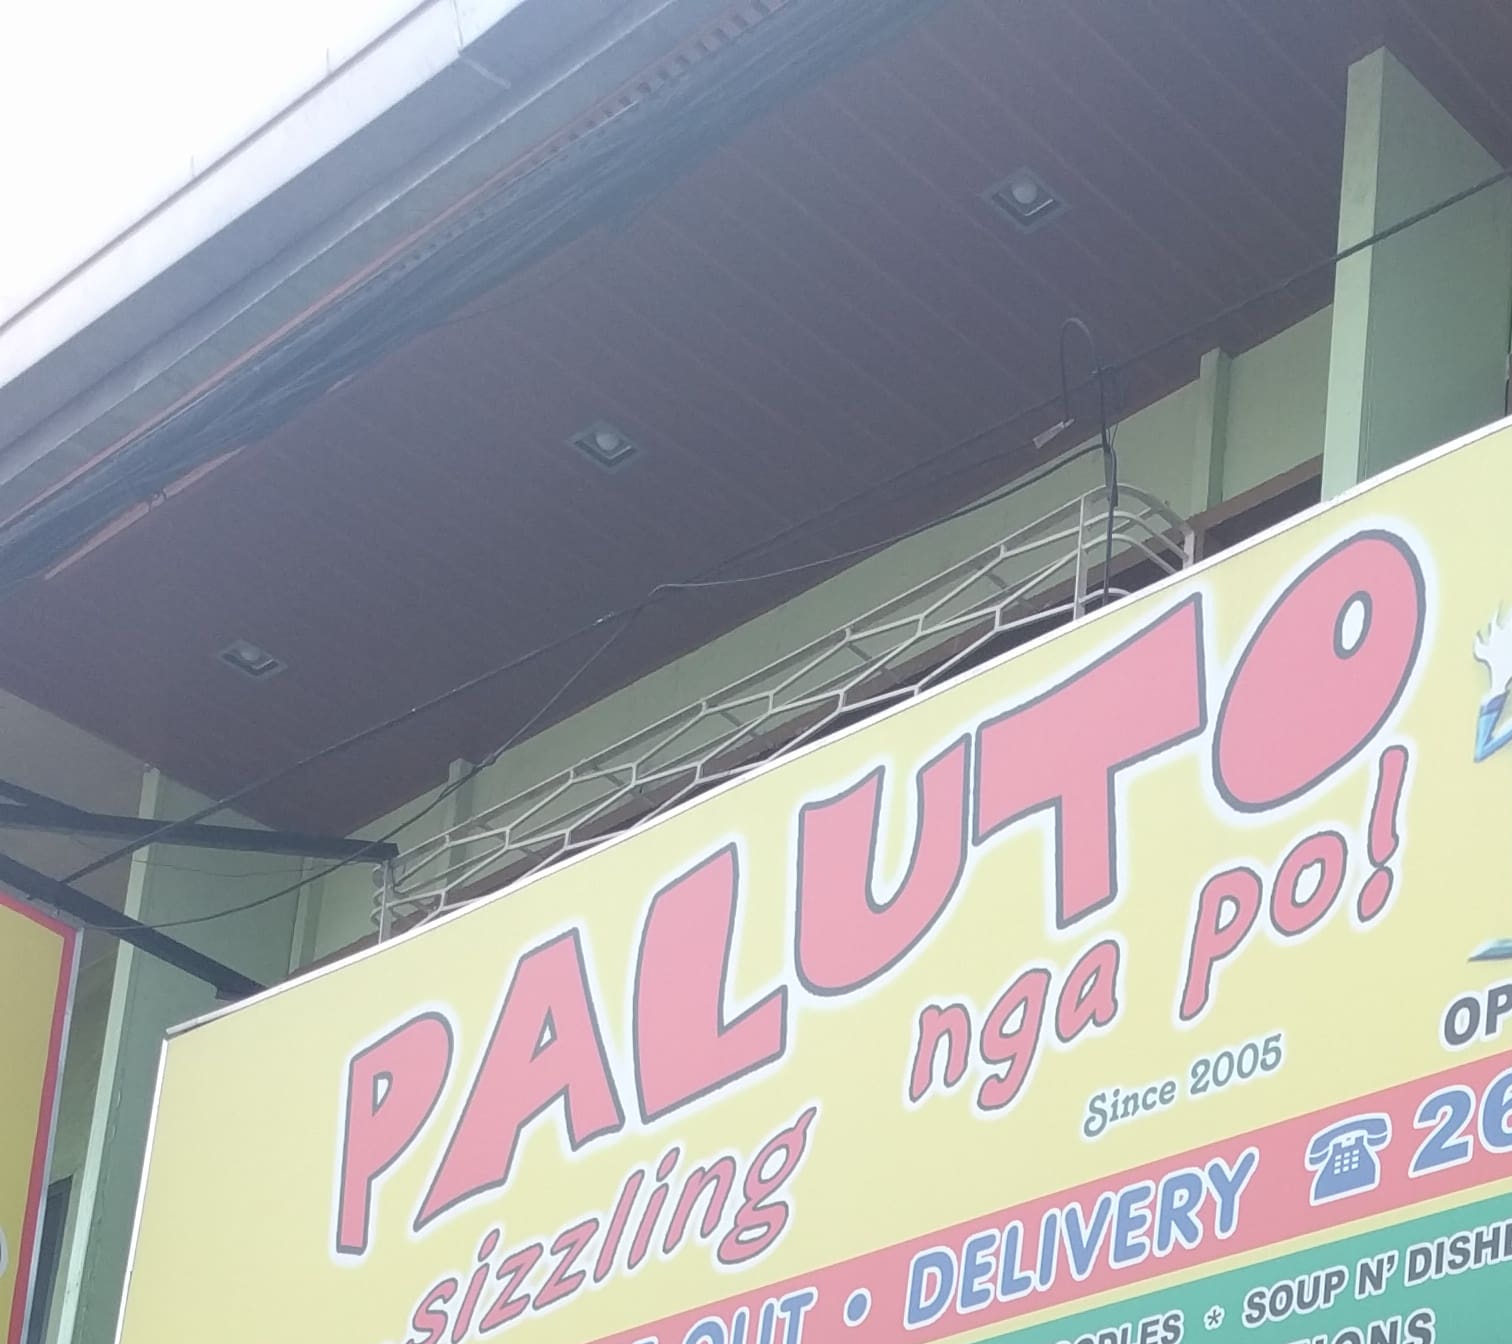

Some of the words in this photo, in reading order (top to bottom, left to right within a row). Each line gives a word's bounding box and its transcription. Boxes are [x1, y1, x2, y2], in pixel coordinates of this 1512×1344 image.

[336, 528, 1425, 1253] PALUTO
[907, 939, 1118, 1110] nga
[1179, 744, 1408, 1020] po!
[1083, 1078, 1176, 1138] Since
[1188, 1032, 1282, 1092] 2005
[905, 1148, 1258, 1330] DELIVERY
[1244, 1264, 1348, 1326] SOUP
